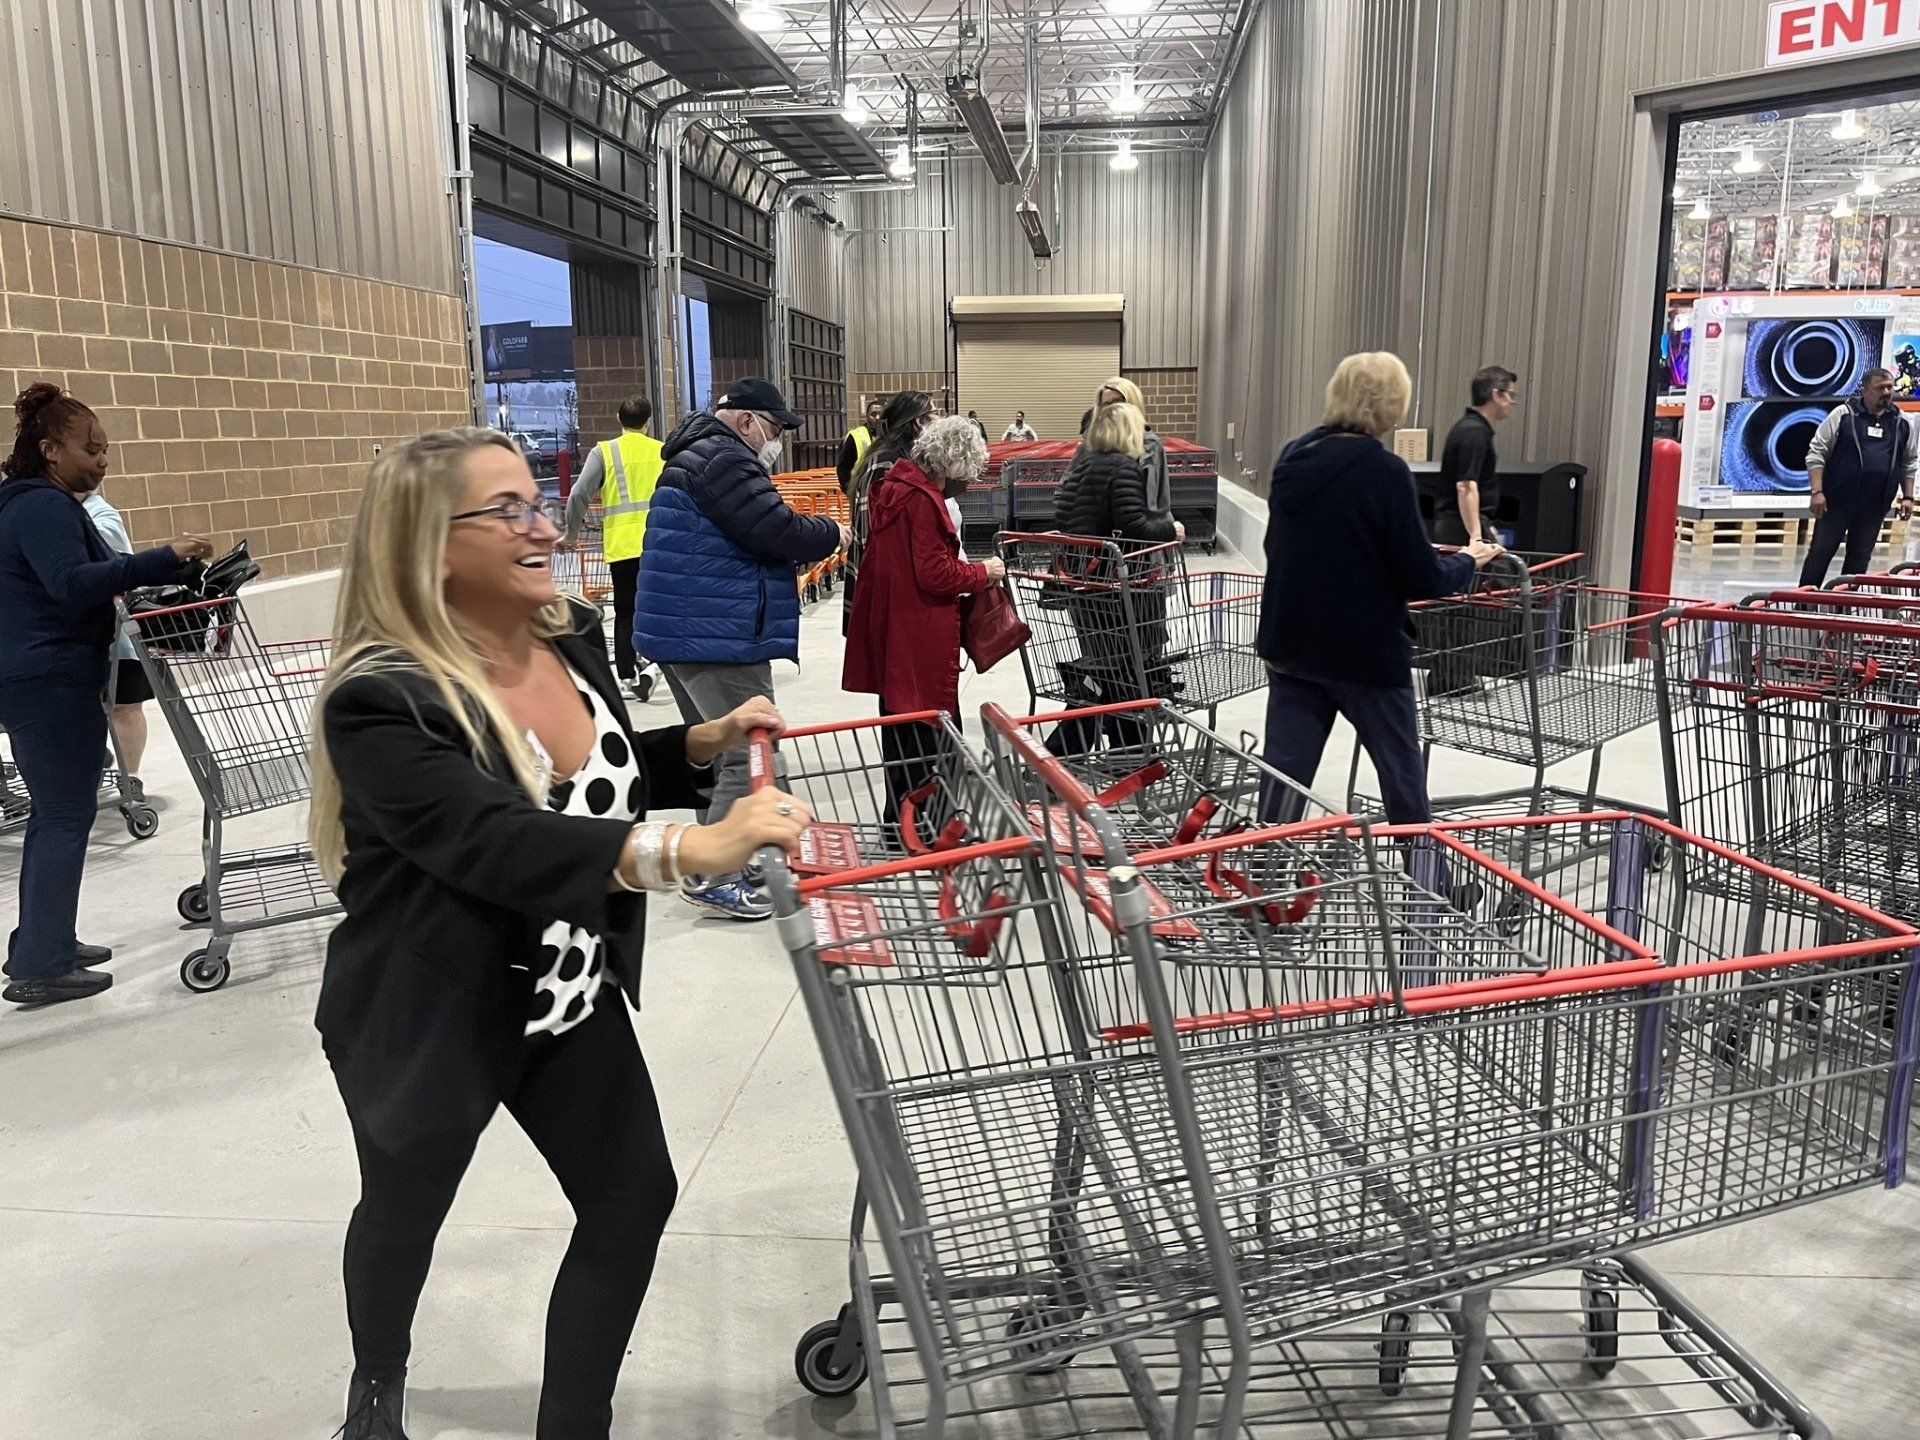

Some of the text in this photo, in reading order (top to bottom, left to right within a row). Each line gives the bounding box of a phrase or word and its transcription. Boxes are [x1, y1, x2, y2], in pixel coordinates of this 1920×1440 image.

[1778, 0, 1920, 55] ENT
[1731, 299, 1754, 315] LG
[502, 336, 528, 345] GOLDFARB
